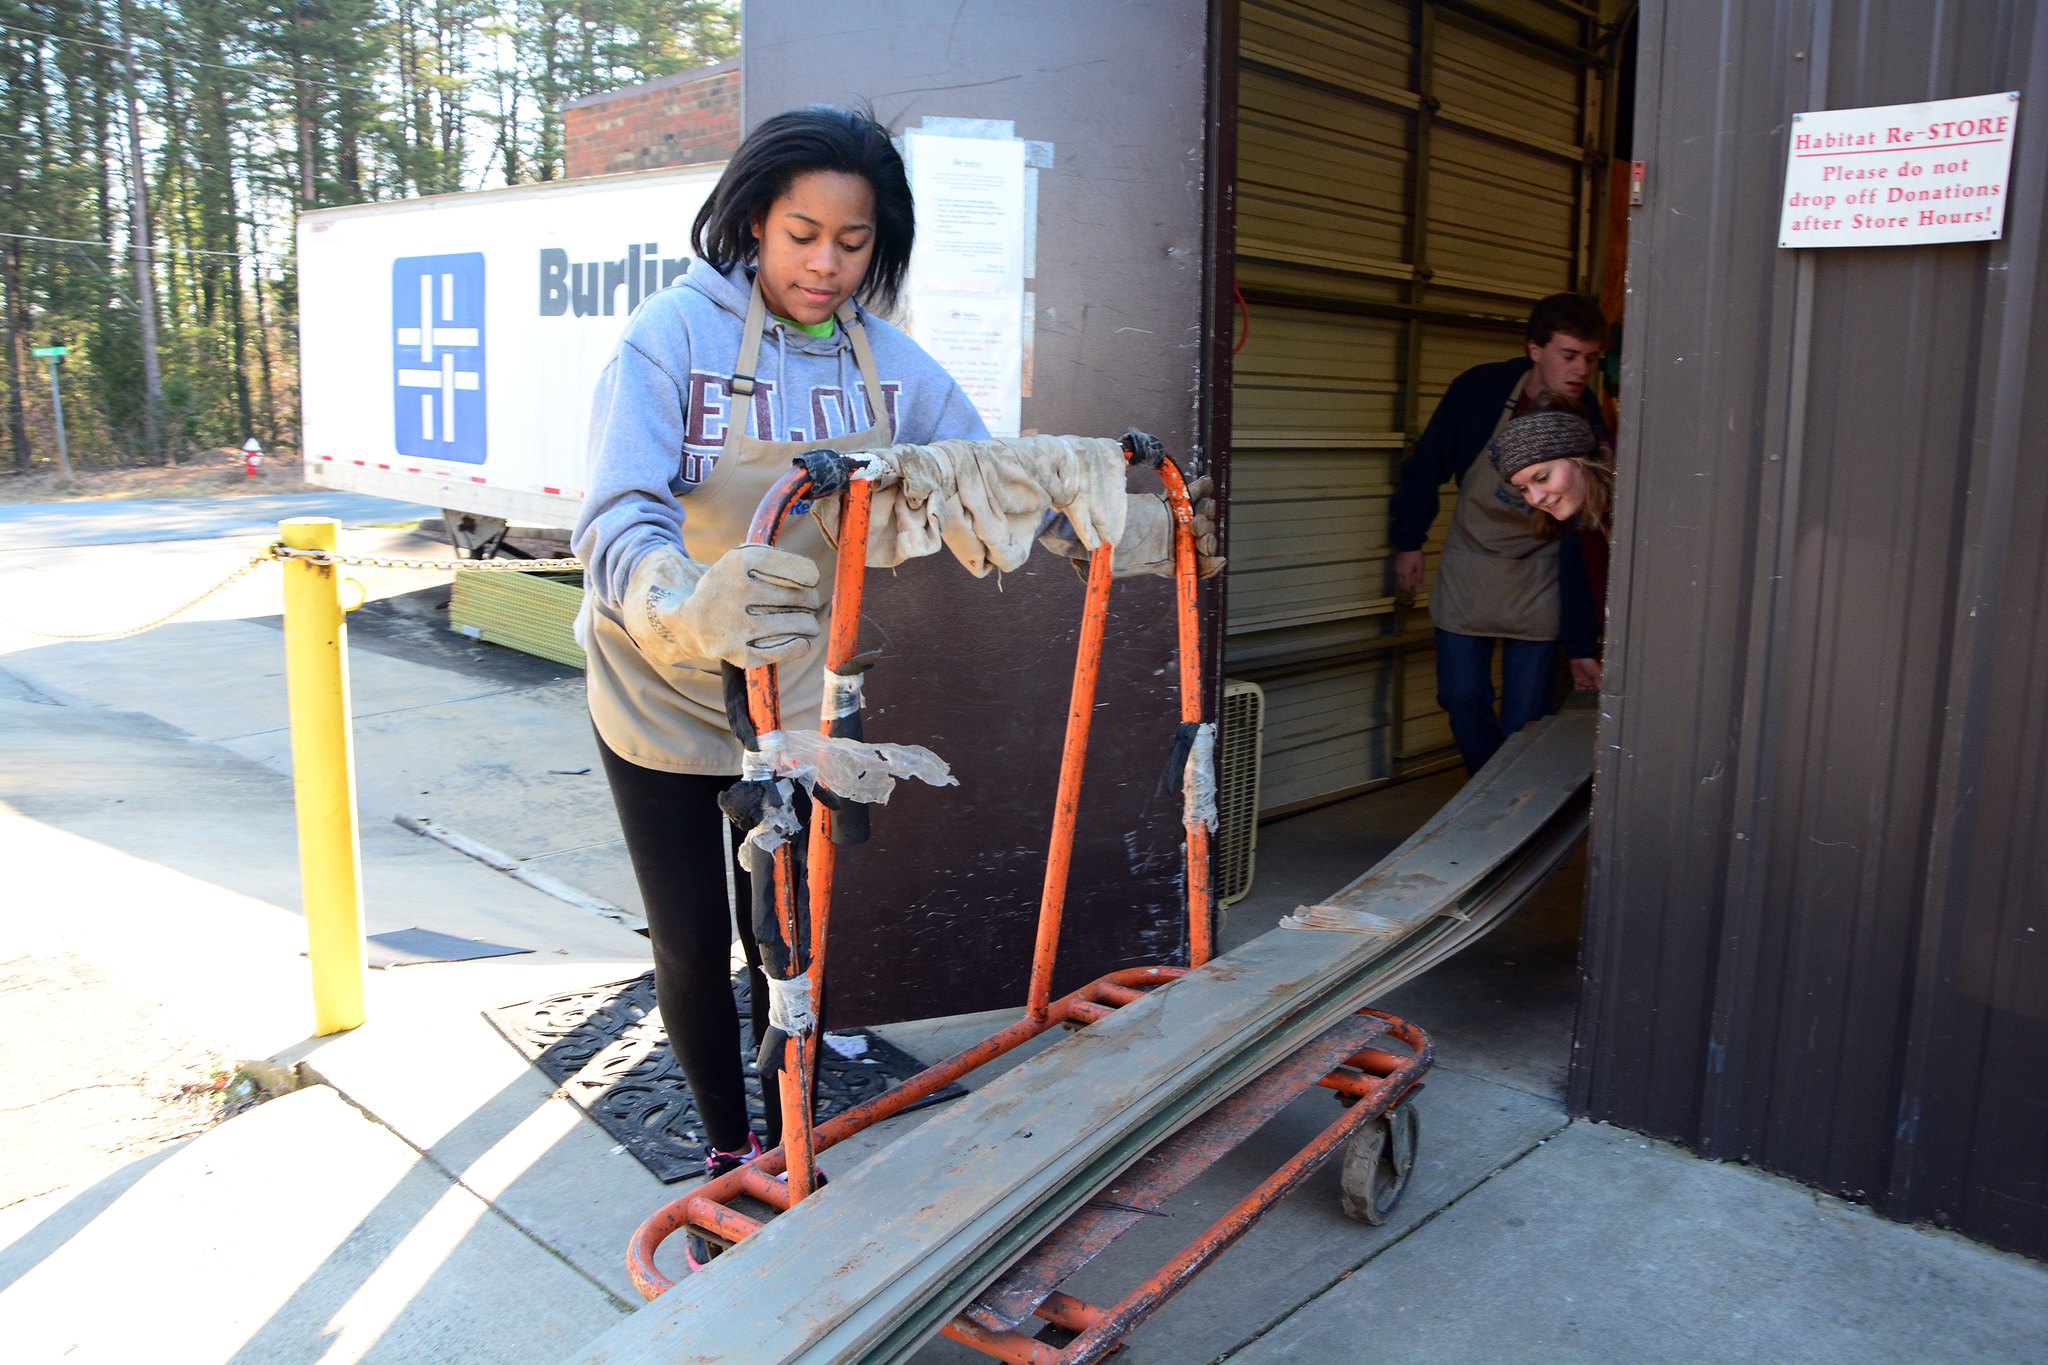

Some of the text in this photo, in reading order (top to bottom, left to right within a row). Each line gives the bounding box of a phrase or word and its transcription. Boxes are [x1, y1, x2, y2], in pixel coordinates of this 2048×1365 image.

[1795, 116, 2009, 150] Habitat Re-STORE
[1822, 159, 1970, 181] Please do not
[1789, 183, 2001, 209] drop off Donations
[1792, 206, 1992, 231] after Store Hours!
